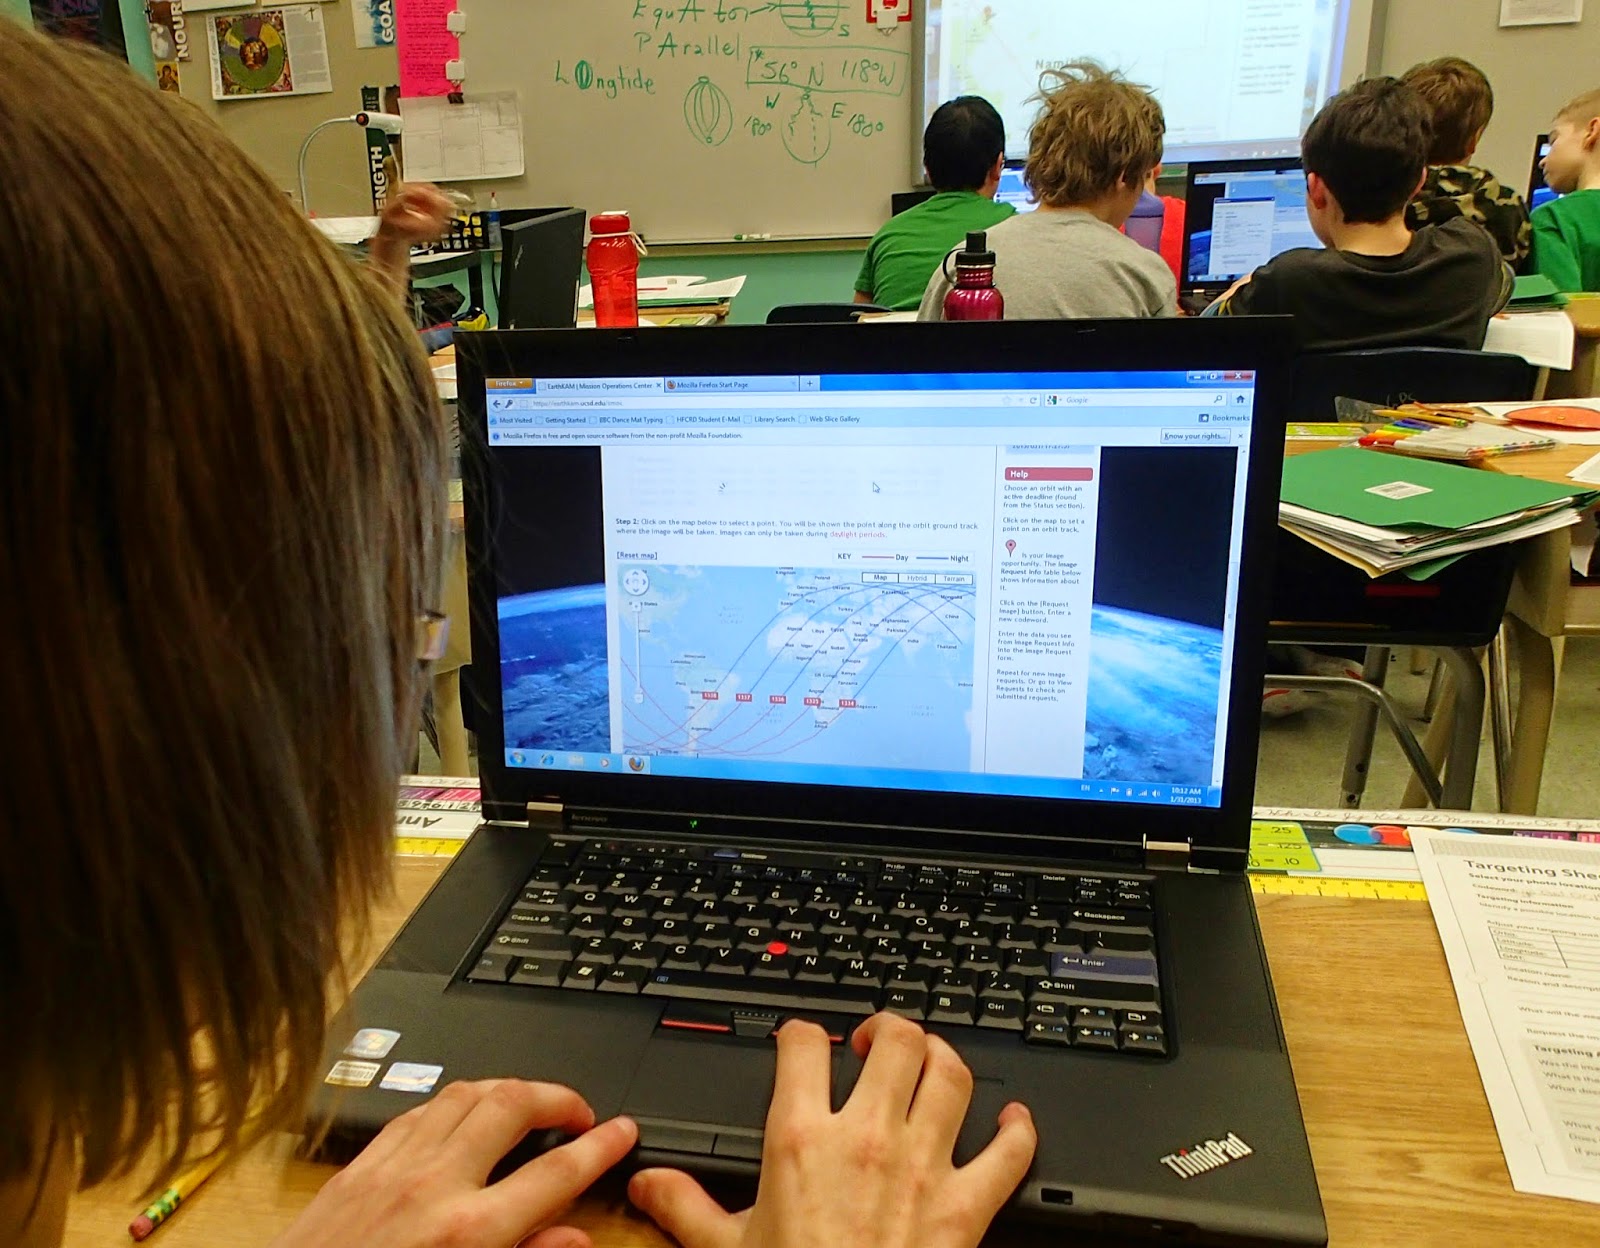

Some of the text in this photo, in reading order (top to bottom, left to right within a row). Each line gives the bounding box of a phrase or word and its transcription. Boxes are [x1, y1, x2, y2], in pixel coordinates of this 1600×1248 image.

[170, 2, 189, 58] NOUR
[370, 146, 387, 212] ENGTH
[602, 383, 632, 391] Operations
[734, 381, 748, 389] Page
[546, 417, 566, 425] Getting
[643, 416, 663, 425] Typing
[754, 415, 795, 424] Library Search
[840, 415, 860, 424] Gallery
[1212, 414, 1250, 422] Bookmarks
[657, 431, 685, 440] non-profit
[708, 431, 743, 439] Foundation.
[1164, 432, 1183, 440] Know
[1010, 470, 1029, 480] Help
[616, 518, 631, 527] Step
[641, 518, 656, 526] Click
[757, 520, 776, 528] point.
[857, 521, 875, 529] point
[878, 521, 896, 530] along
[933, 523, 957, 531] ground
[758, 530, 772, 538] only
[806, 530, 828, 539] during
[830, 531, 857, 539] daylight
[896, 554, 909, 562] Day
[950, 555, 969, 563] Night
[873, 574, 965, 583] Map Hybrid Terrain
[1080, 784, 1090, 792] EN
[1170, 796, 1202, 804] 1/31/2013
[1463, 859, 1600, 880] Targeting She
[1118, 879, 1139, 888] PgUp
[1469, 872, 1557, 887] Select your photo
[1119, 893, 1140, 901] PgDn
[584, 893, 798, 916] Q W E R T Y
[1084, 911, 1126, 921] Backspace
[1081, 957, 1105, 967] Enter
[1054, 981, 1075, 990] Shift
[988, 1002, 1004, 1011] Ctrl
[1534, 1044, 1593, 1058] Targeting
[1160, 1131, 1253, 1180] ThinkPad
